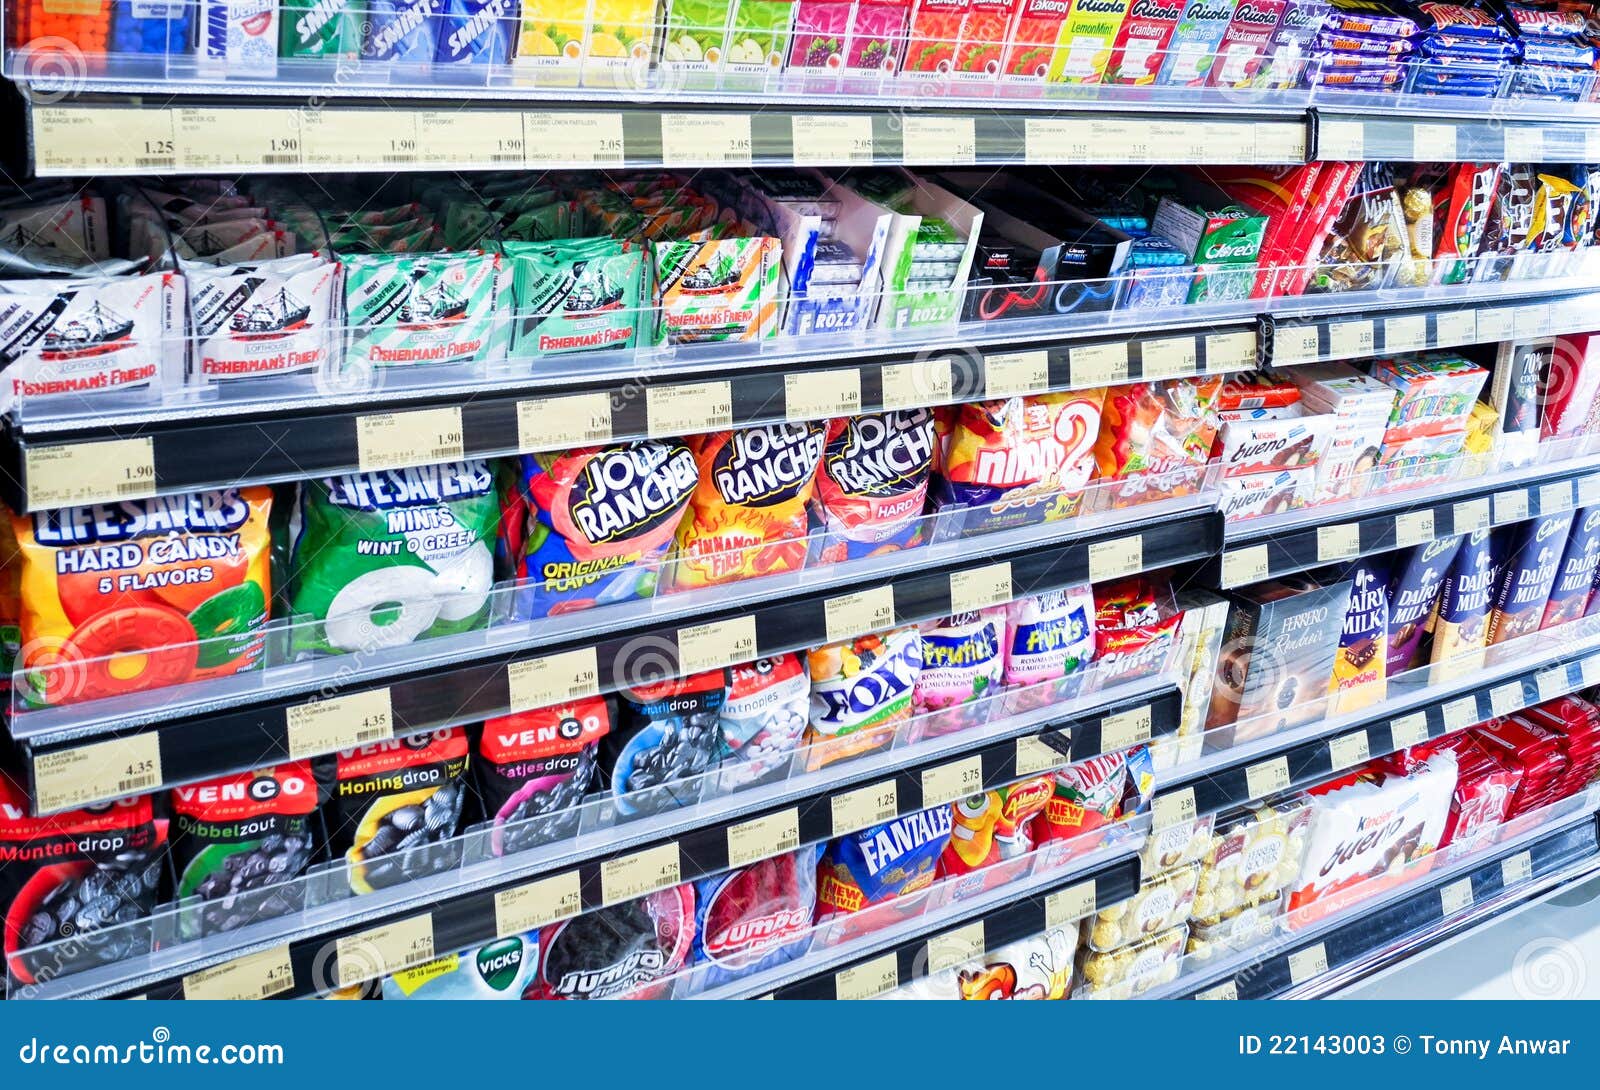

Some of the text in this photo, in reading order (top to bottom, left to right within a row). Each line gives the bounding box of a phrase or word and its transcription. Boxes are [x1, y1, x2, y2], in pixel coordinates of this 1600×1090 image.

[1132, 0, 1180, 20] Ricola
[1187, 2, 1230, 21] Ricola
[1235, 4, 1278, 25] Ricola
[1128, 24, 1167, 40] Cranberry
[144, 141, 174, 154] 1.25
[270, 139, 297, 151] 1.90
[390, 140, 415, 151] 1.90
[498, 140, 521, 151] 1.90
[599, 140, 621, 151] 2.05
[729, 140, 750, 151] 2.05
[854, 140, 872, 150] 2.05
[1205, 243, 1257, 260] Clorets
[364, 280, 380, 295] MINT
[532, 284, 554, 305] STRONG
[363, 281, 398, 312] SUGARFREE
[1303, 338, 1317, 349] 5.65
[1522, 352, 1544, 370] 70%
[1033, 371, 1047, 381] 2.60
[932, 381, 948, 391] 1.40
[841, 391, 857, 401] 1.40
[712, 404, 730, 415] 1.90
[591, 417, 611, 428] 1.90
[438, 433, 461, 445] 1.90
[1230, 438, 1287, 462] bueno
[125, 465, 153, 480] 1.90
[716, 432, 824, 505] RANCHER
[576, 450, 699, 542] RANCHER
[1225, 488, 1274, 515] bueno
[878, 501, 914, 519] HARD
[387, 508, 455, 534] MINTS
[357, 529, 478, 556] WINT O GREEN
[689, 536, 763, 562] CINNAMON
[57, 534, 242, 574] HARD CANDY
[1565, 549, 1600, 574] DAIRY
[543, 555, 627, 578] ORIGINAL
[1518, 560, 1555, 586] DAIRY
[99, 567, 213, 593] 5 FLAVORS
[995, 581, 1009, 592] 2.95
[1458, 565, 1499, 593] DAIRY
[1560, 572, 1594, 592] MILK
[1398, 579, 1443, 606] DAIRY
[1513, 582, 1549, 604] MILK
[1456, 591, 1490, 612] MILK
[874, 607, 890, 617] 4.30
[1282, 606, 1328, 634] FERRERO
[1391, 600, 1433, 624] MILK
[734, 638, 752, 649] 4.30
[573, 671, 594, 683] 4.30
[362, 713, 386, 728] 4.35
[1136, 718, 1150, 730] 1.25
[499, 715, 600, 748] VENCO
[126, 760, 154, 775] 4.35
[962, 769, 980, 783] 3.75
[175, 776, 305, 804] VENCO
[339, 768, 440, 796] Honingdrop
[877, 793, 895, 808] 1.25
[1006, 784, 1050, 816] Allen's
[1180, 798, 1194, 809] 2.90
[1049, 801, 1081, 818] NEW
[178, 815, 276, 842] Dubbelzout
[780, 828, 798, 839] 4.75
[660, 862, 679, 875] 4.75
[559, 892, 579, 905] 4.75
[826, 879, 862, 903] NEW
[411, 936, 432, 948] 4.75
[479, 952, 521, 974] VICKS
[267, 965, 291, 980] 4.75
[559, 950, 664, 994] Jumbo
[881, 970, 897, 982] 5.85
